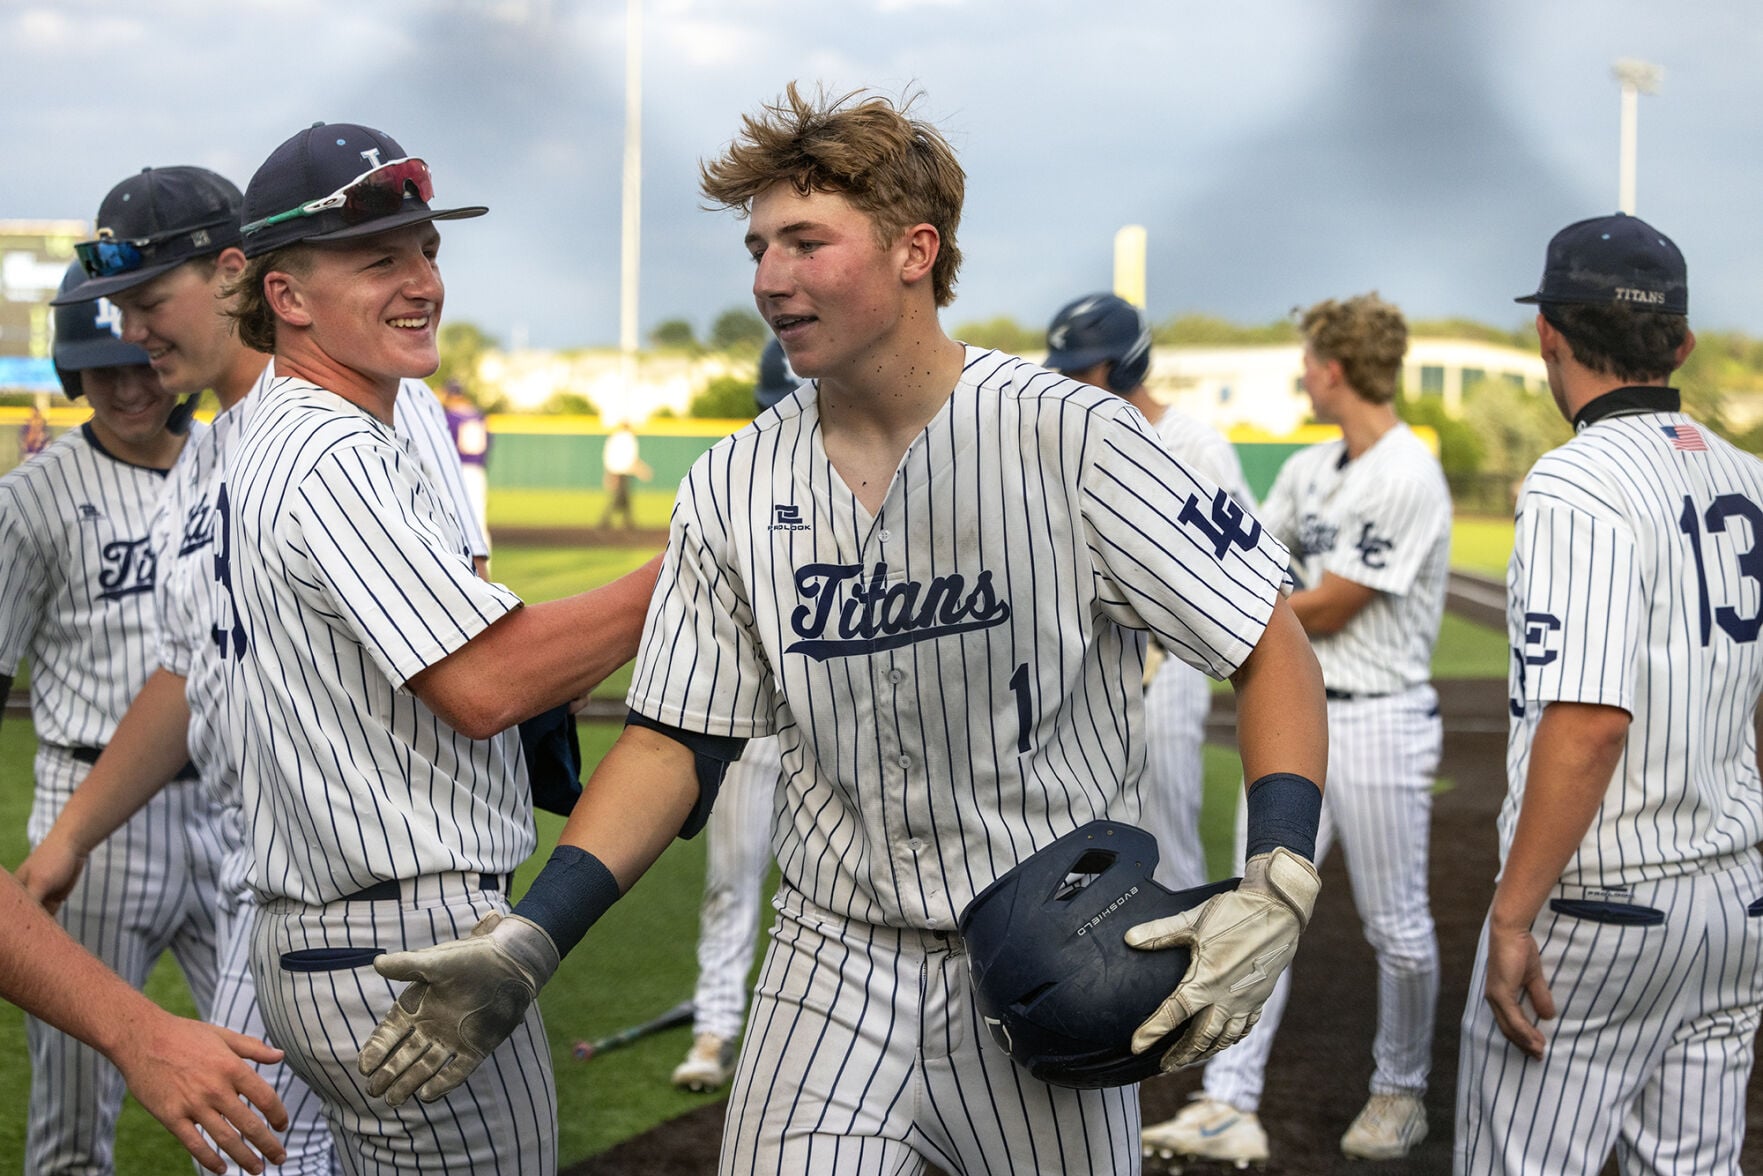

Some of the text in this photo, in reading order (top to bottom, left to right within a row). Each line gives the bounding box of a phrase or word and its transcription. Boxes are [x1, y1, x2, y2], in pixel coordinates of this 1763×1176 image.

[1614, 287, 1666, 305] TITANS
[789, 561, 1010, 645] Titans
[1680, 493, 1763, 644] 13
[1009, 662, 1033, 754] 1
[1077, 886, 1139, 936] EVOSHIELD
